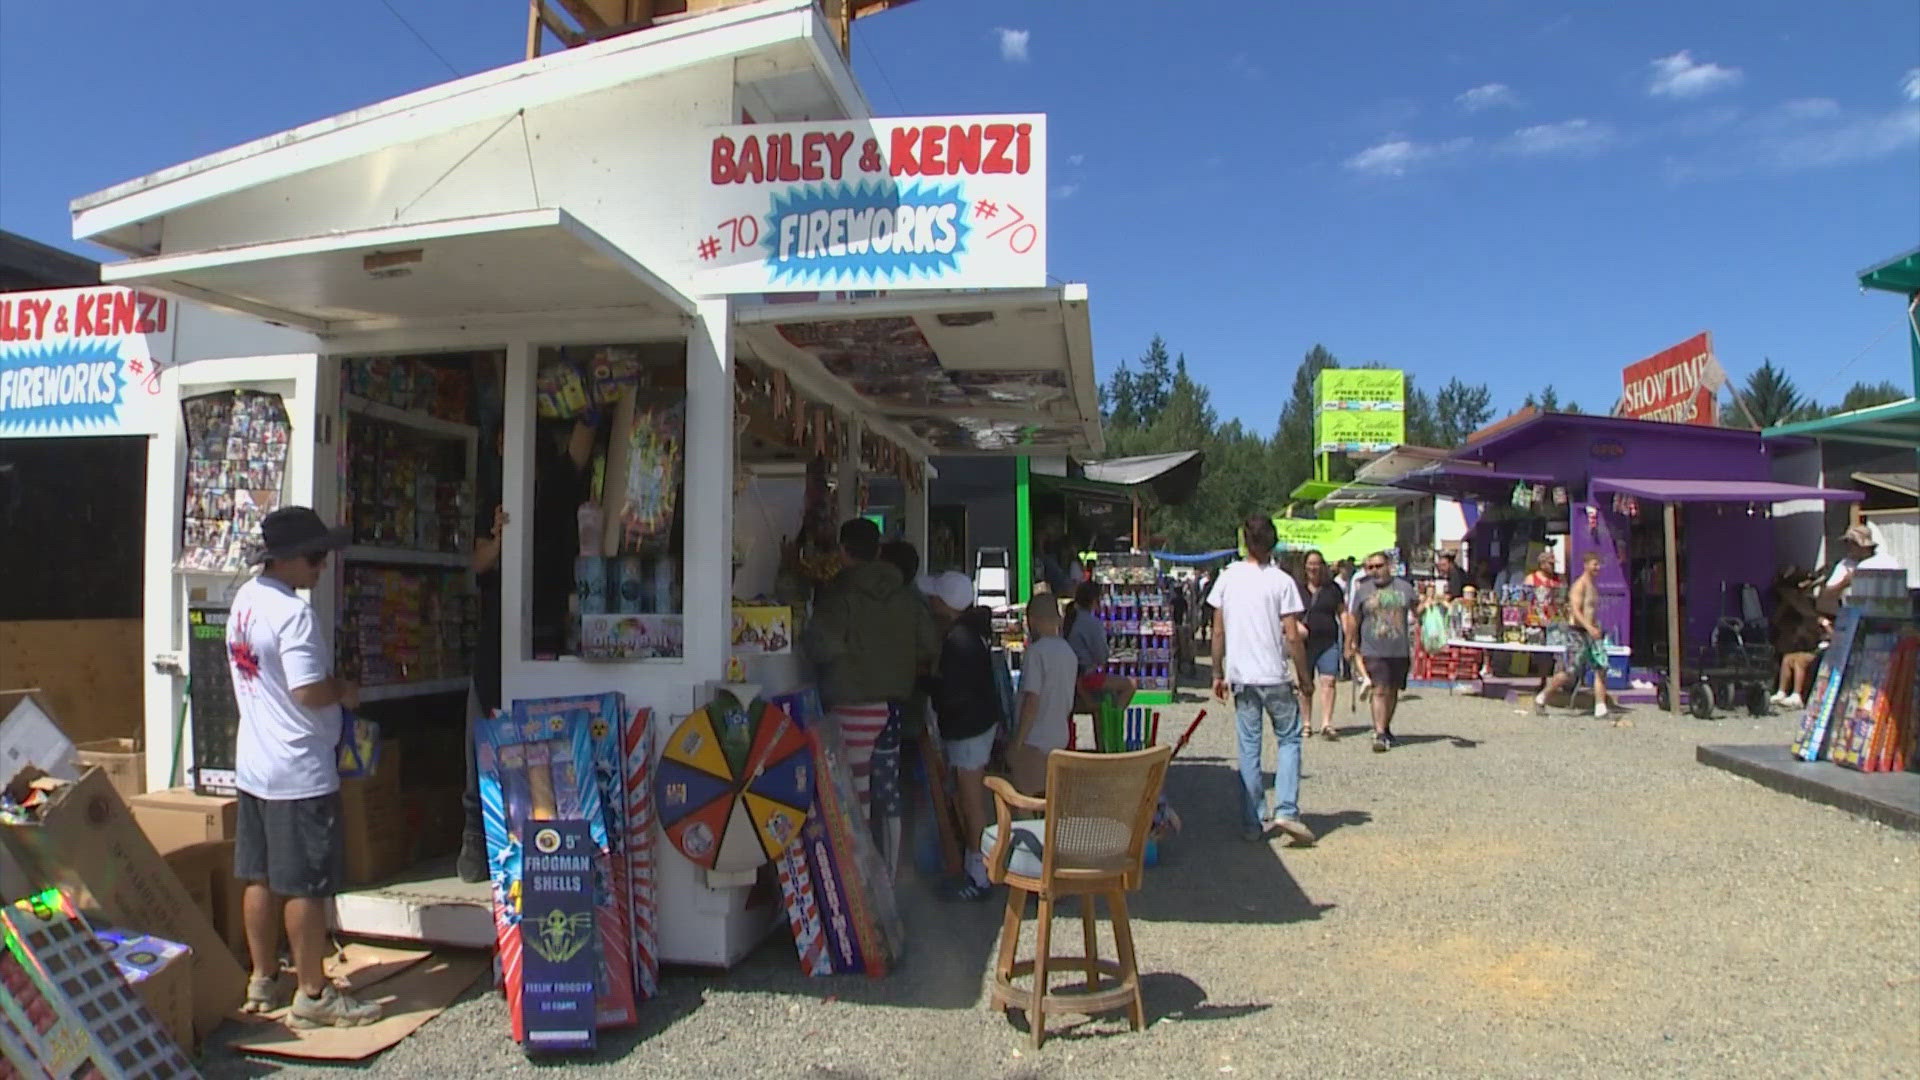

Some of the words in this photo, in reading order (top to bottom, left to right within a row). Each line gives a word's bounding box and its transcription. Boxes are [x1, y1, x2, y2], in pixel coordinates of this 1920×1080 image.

[859, 140, 881, 173] &
[778, 203, 957, 262] FIREWORKS
[54, 305, 69, 333] &
[0, 361, 117, 412] FIREWORKS
[525, 855, 590, 872] FROGMAN
[533, 876, 581, 892] SHELLS
